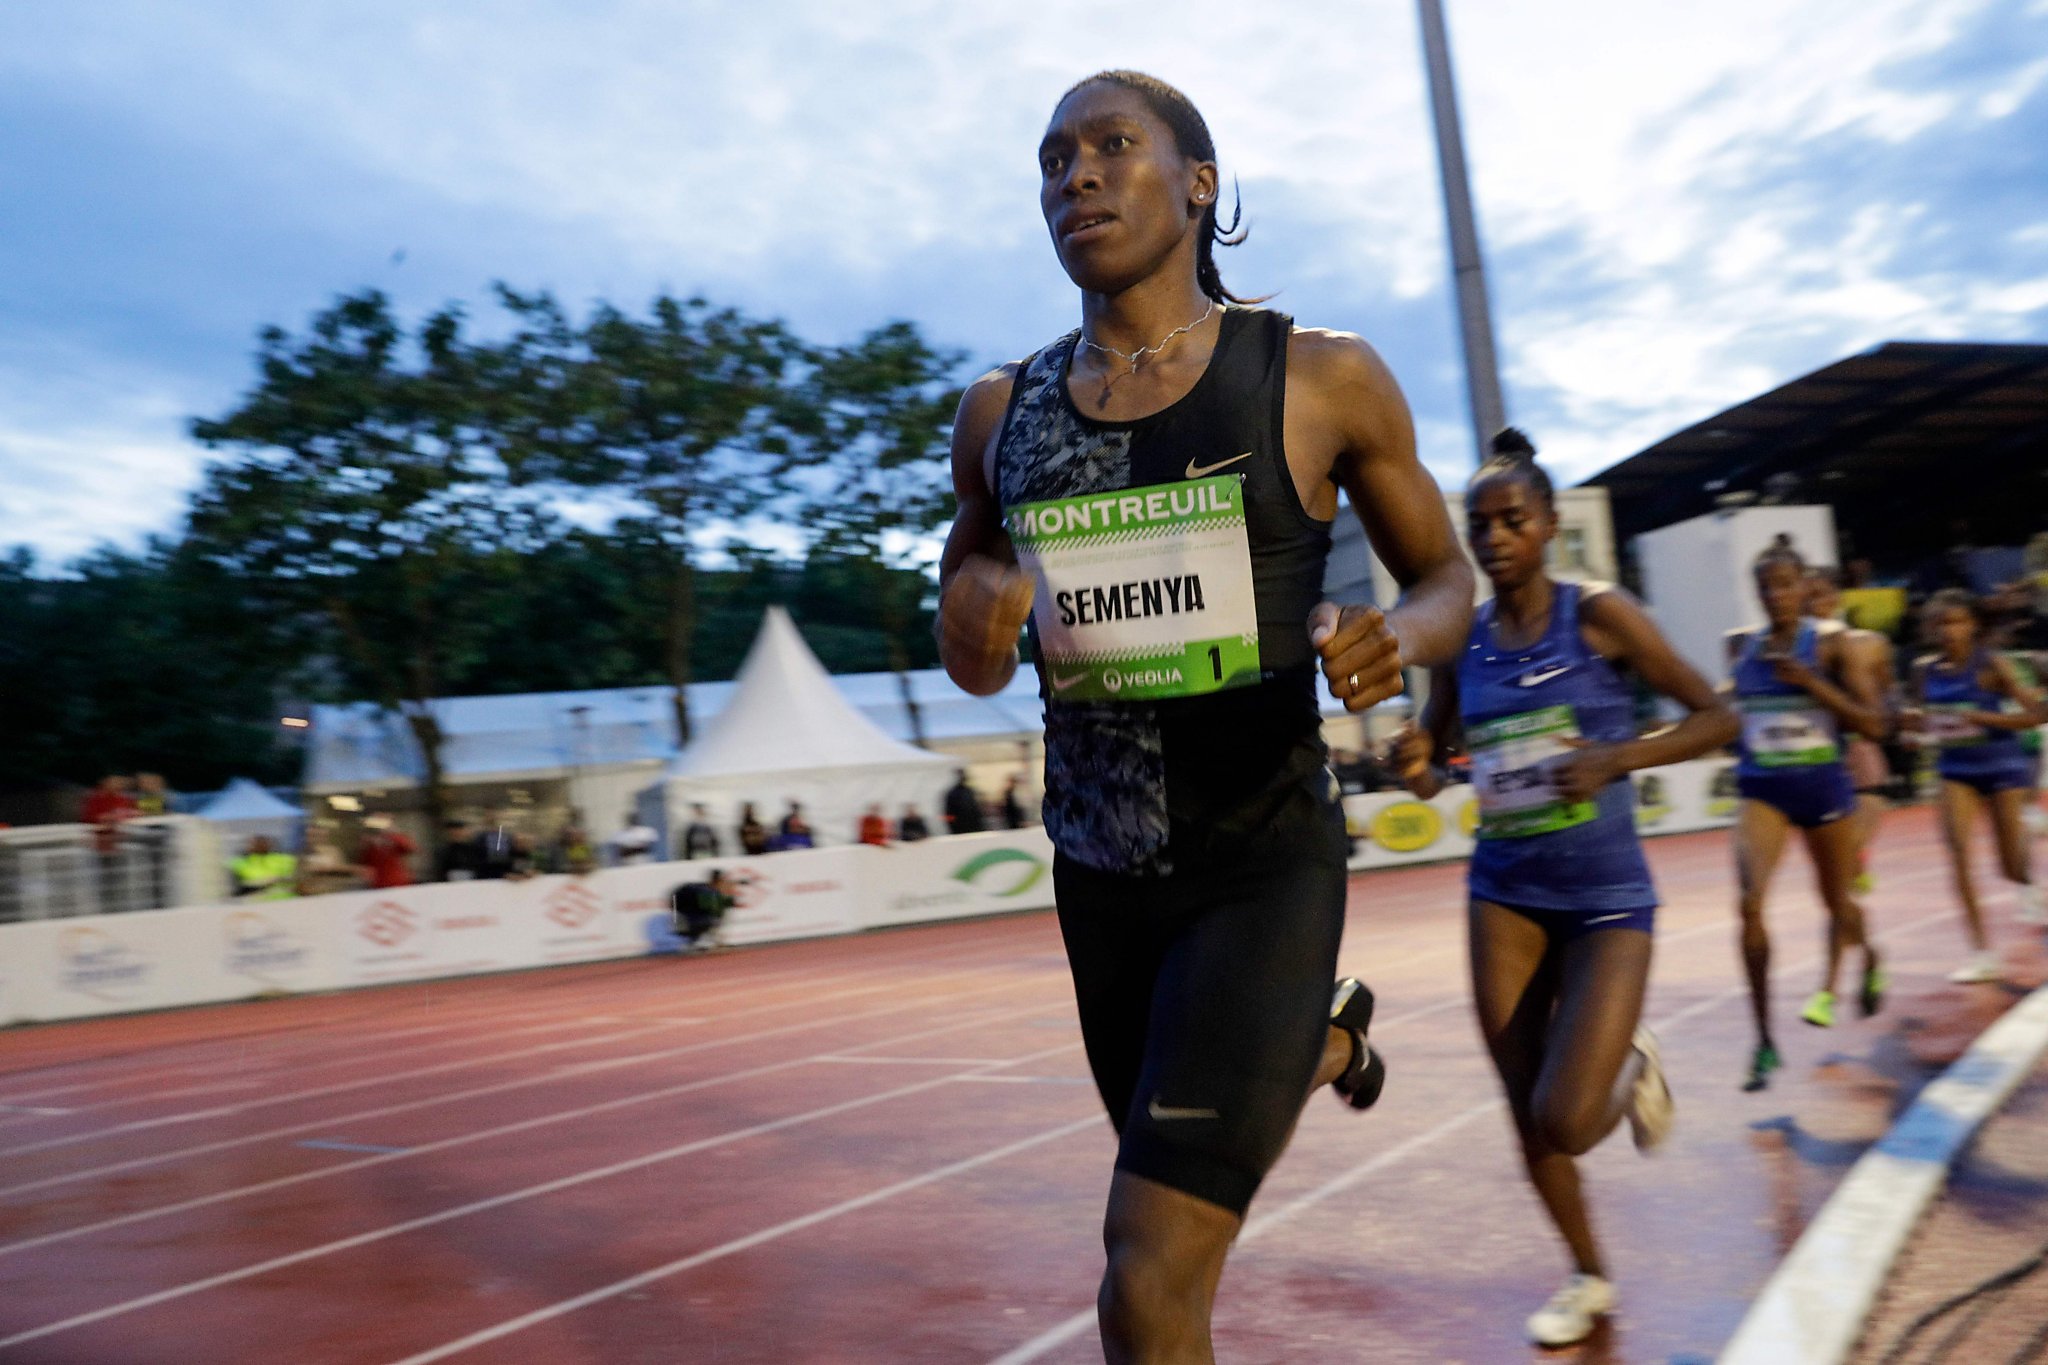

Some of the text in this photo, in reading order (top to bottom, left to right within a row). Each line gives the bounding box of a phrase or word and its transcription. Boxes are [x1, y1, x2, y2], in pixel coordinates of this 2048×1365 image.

[1012, 485, 1232, 537] MONTREUIL
[1056, 574, 1205, 626] SEMENYA
[1125, 668, 1183, 689] VEOLIA
[1207, 645, 1223, 682] 1
